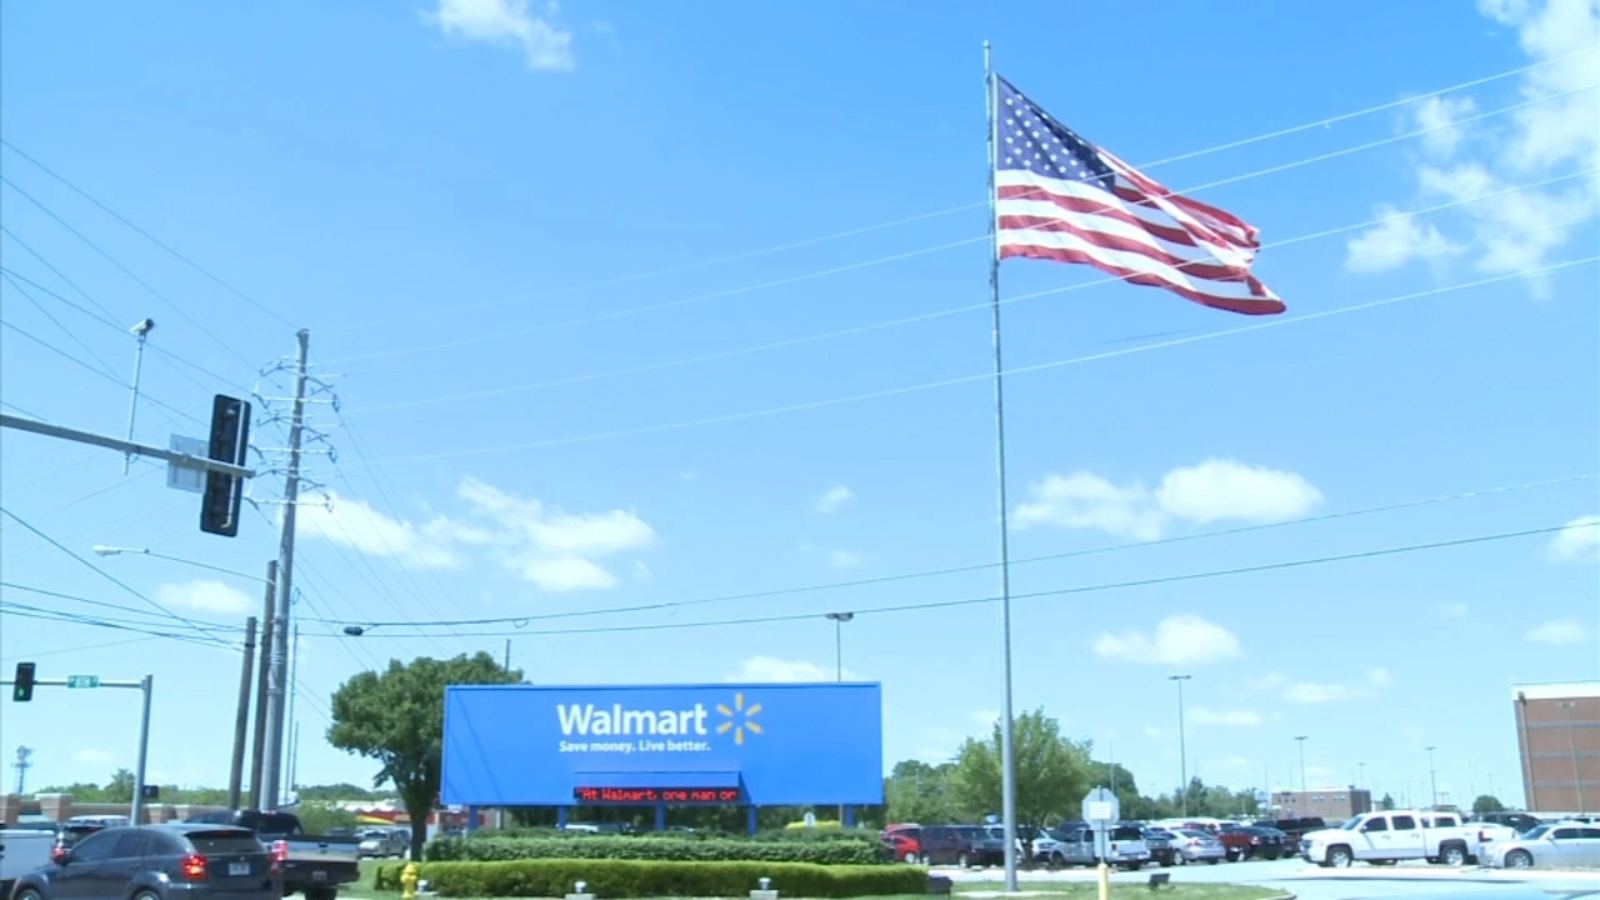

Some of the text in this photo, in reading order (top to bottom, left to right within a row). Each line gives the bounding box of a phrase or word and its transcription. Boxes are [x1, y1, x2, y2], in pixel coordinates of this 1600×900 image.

[557, 703, 708, 735] Walmart
[559, 740, 711, 754] Save money. Live better.
[663, 790, 687, 800] one
